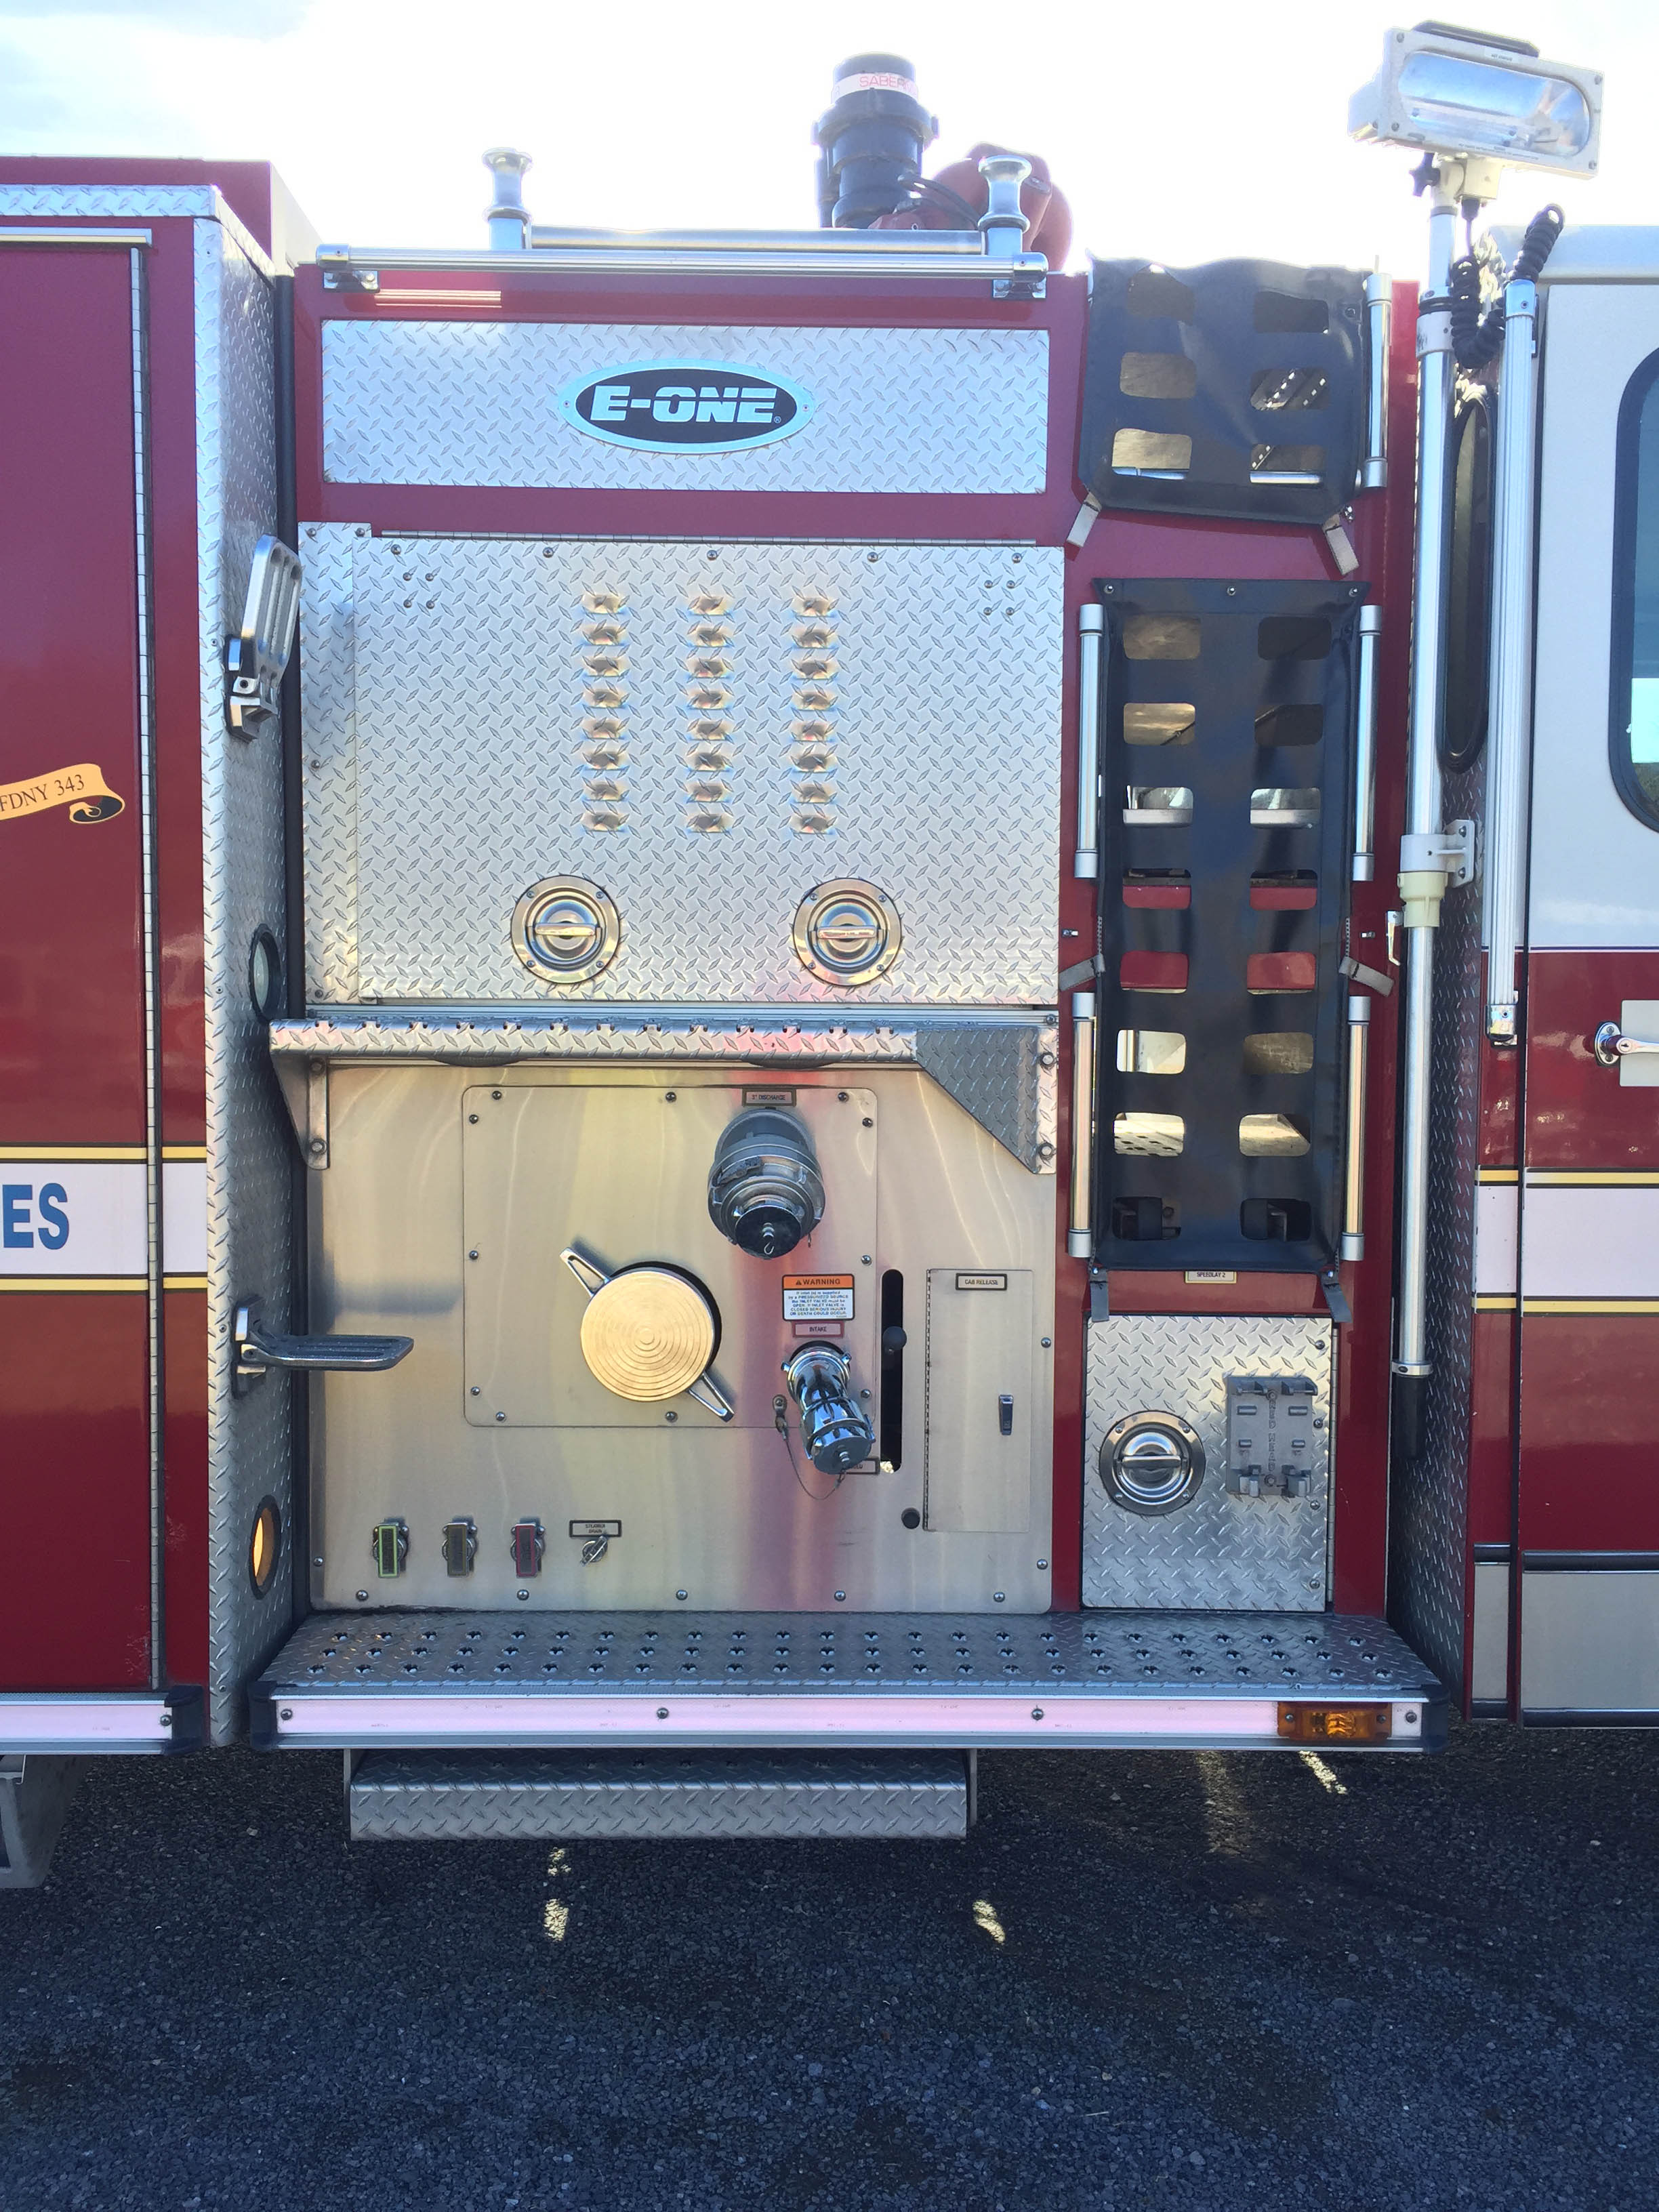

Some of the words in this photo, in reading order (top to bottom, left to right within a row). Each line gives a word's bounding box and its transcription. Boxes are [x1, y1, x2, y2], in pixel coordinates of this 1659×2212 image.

[590, 385, 777, 423] E-ONE
[0, 783, 48, 811] FDNY
[54, 774, 85, 796] 343
